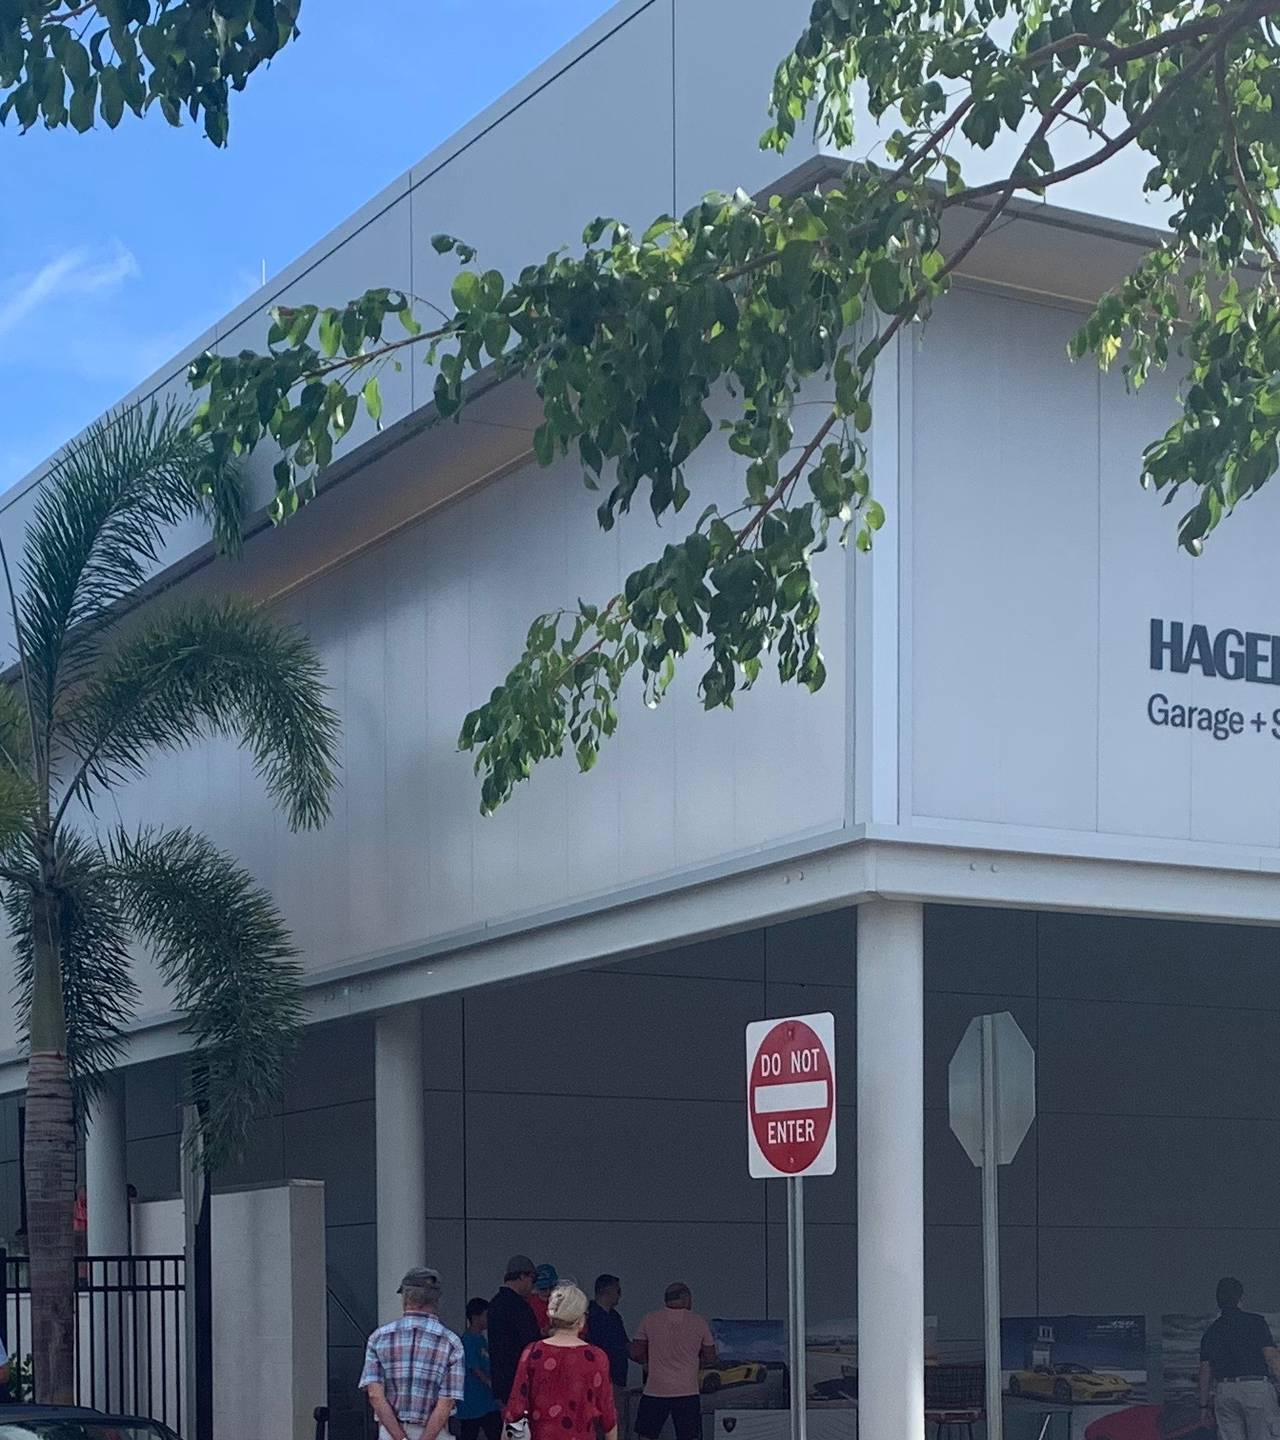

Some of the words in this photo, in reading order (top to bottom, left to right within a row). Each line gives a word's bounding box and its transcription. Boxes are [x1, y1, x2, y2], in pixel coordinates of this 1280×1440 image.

[1147, 693, 1245, 741] Garage
[1250, 712, 1267, 733] +
[761, 1053, 781, 1077] DO
[790, 1048, 820, 1074] NOT
[768, 1119, 815, 1145] ENTER
